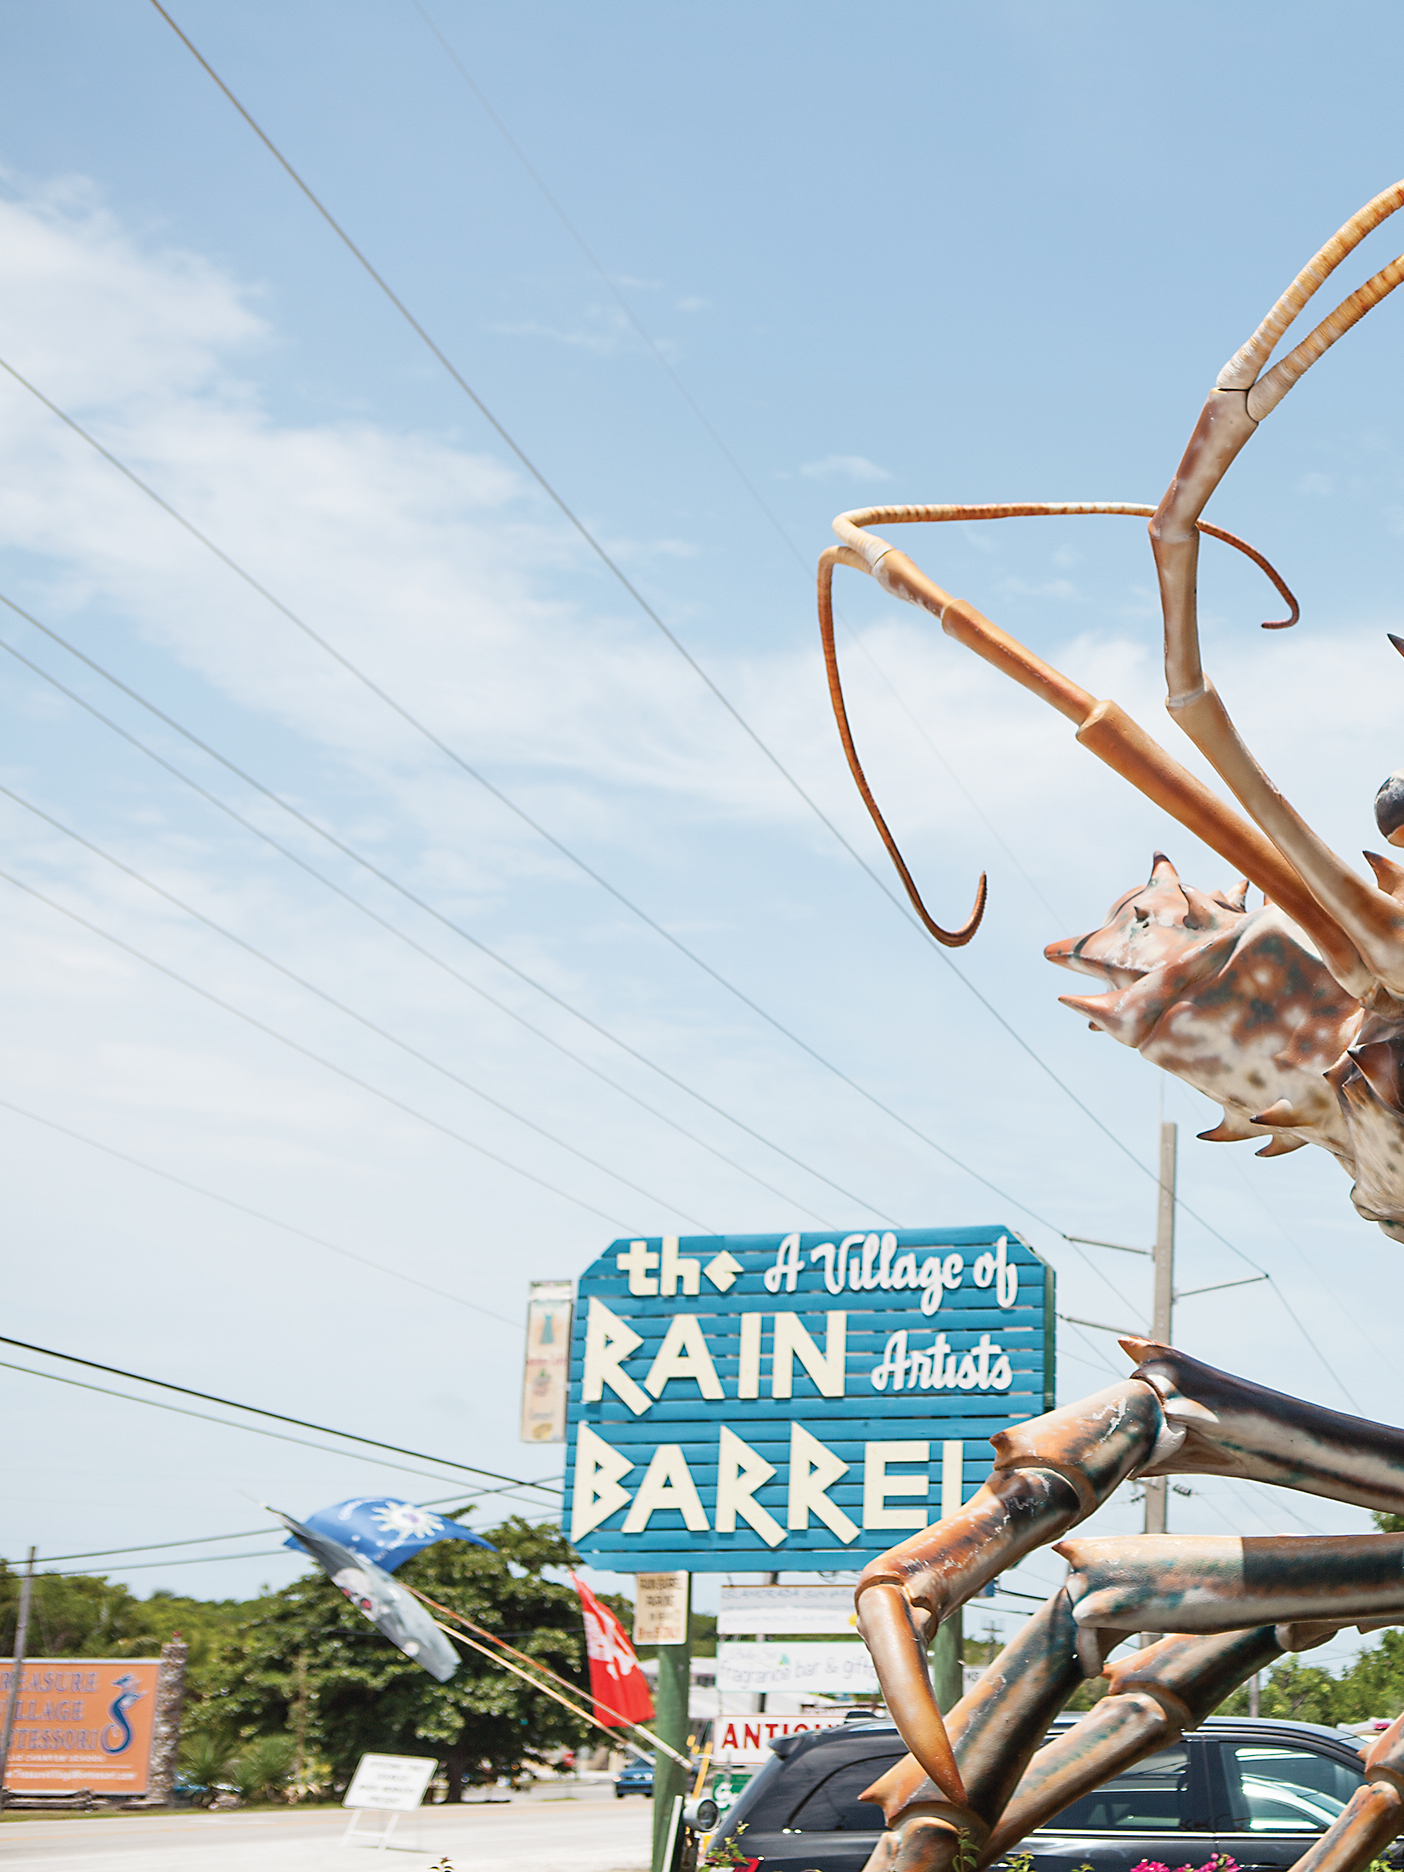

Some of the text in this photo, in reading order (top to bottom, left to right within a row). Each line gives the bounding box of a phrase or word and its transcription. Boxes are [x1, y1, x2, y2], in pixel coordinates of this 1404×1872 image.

[617, 1236, 744, 1296] the
[764, 1231, 1018, 1316] A Village of
[582, 1296, 847, 1416] RAIN
[870, 1330, 1013, 1391] Artists
[0, 1671, 99, 1692] REASURE
[719, 1659, 791, 1689] fragrance
[795, 1657, 820, 1679] bar
